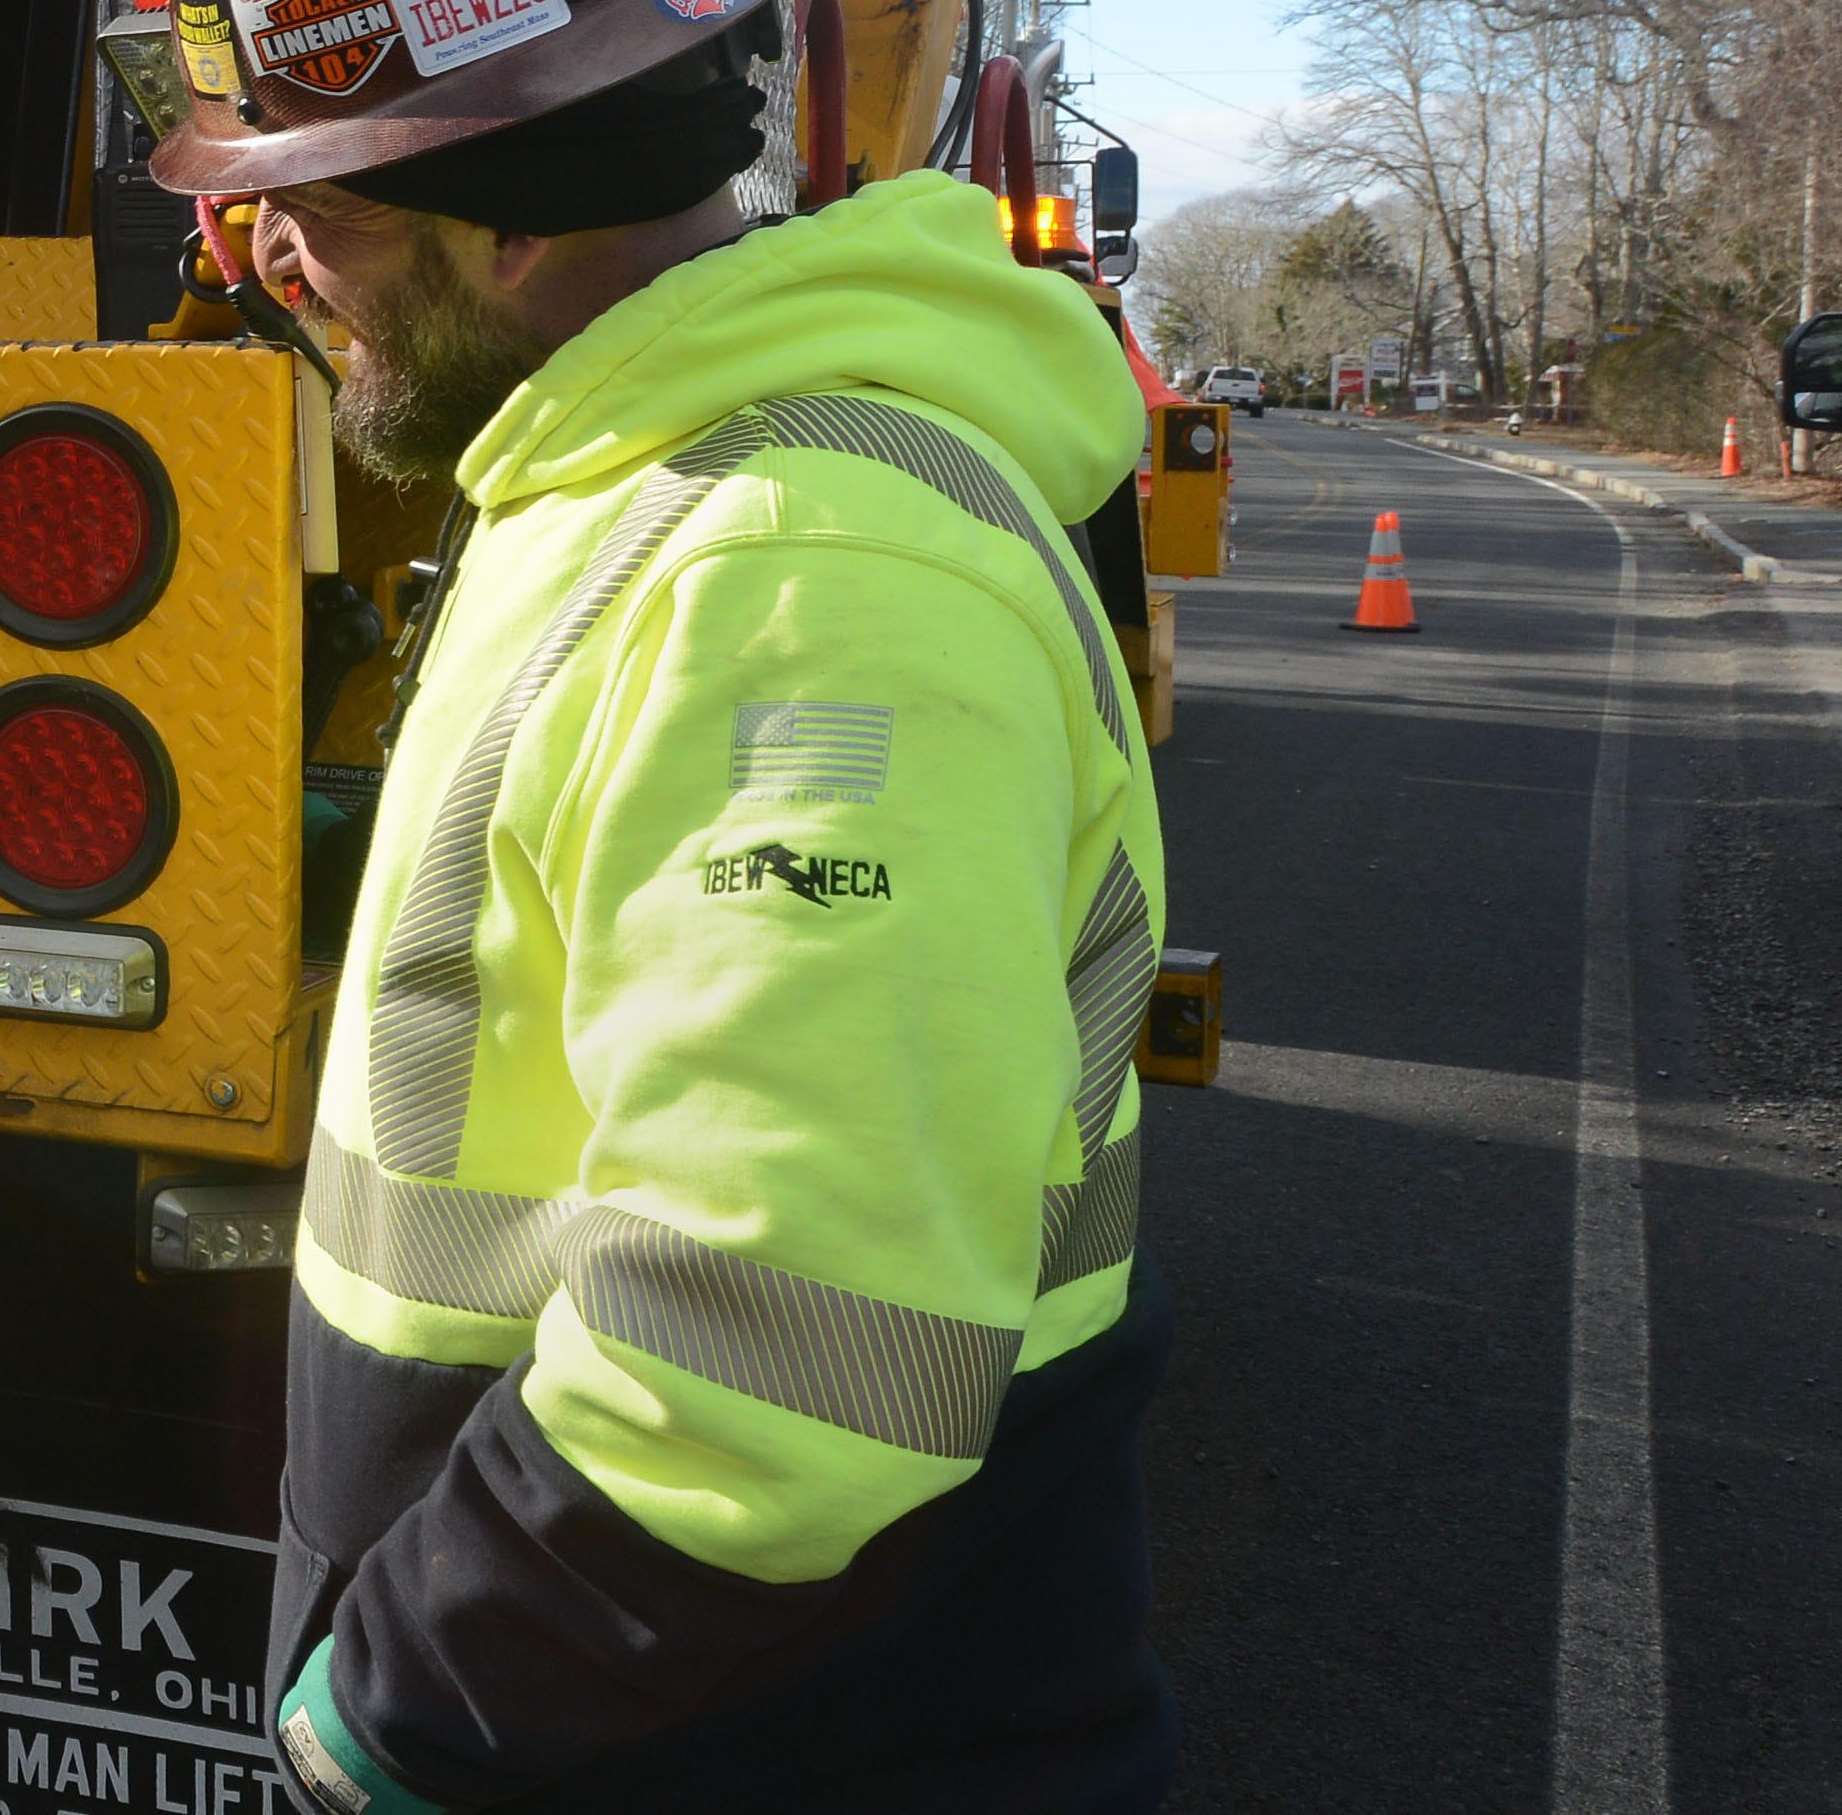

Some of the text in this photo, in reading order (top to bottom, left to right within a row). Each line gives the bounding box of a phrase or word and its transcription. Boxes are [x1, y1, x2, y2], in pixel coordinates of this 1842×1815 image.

[259, 2, 394, 63] LINEMEN
[479, 21, 525, 45] Southeast
[527, 11, 550, 26] Mass
[302, 46, 365, 84] 104
[329, 767, 365, 781] DRIVE
[802, 789, 835, 803] THE
[840, 790, 877, 806] USA
[703, 855, 892, 901] IBEW NECA
[154, 1670, 259, 1726] OHI
[7, 1727, 131, 1805] MAN
